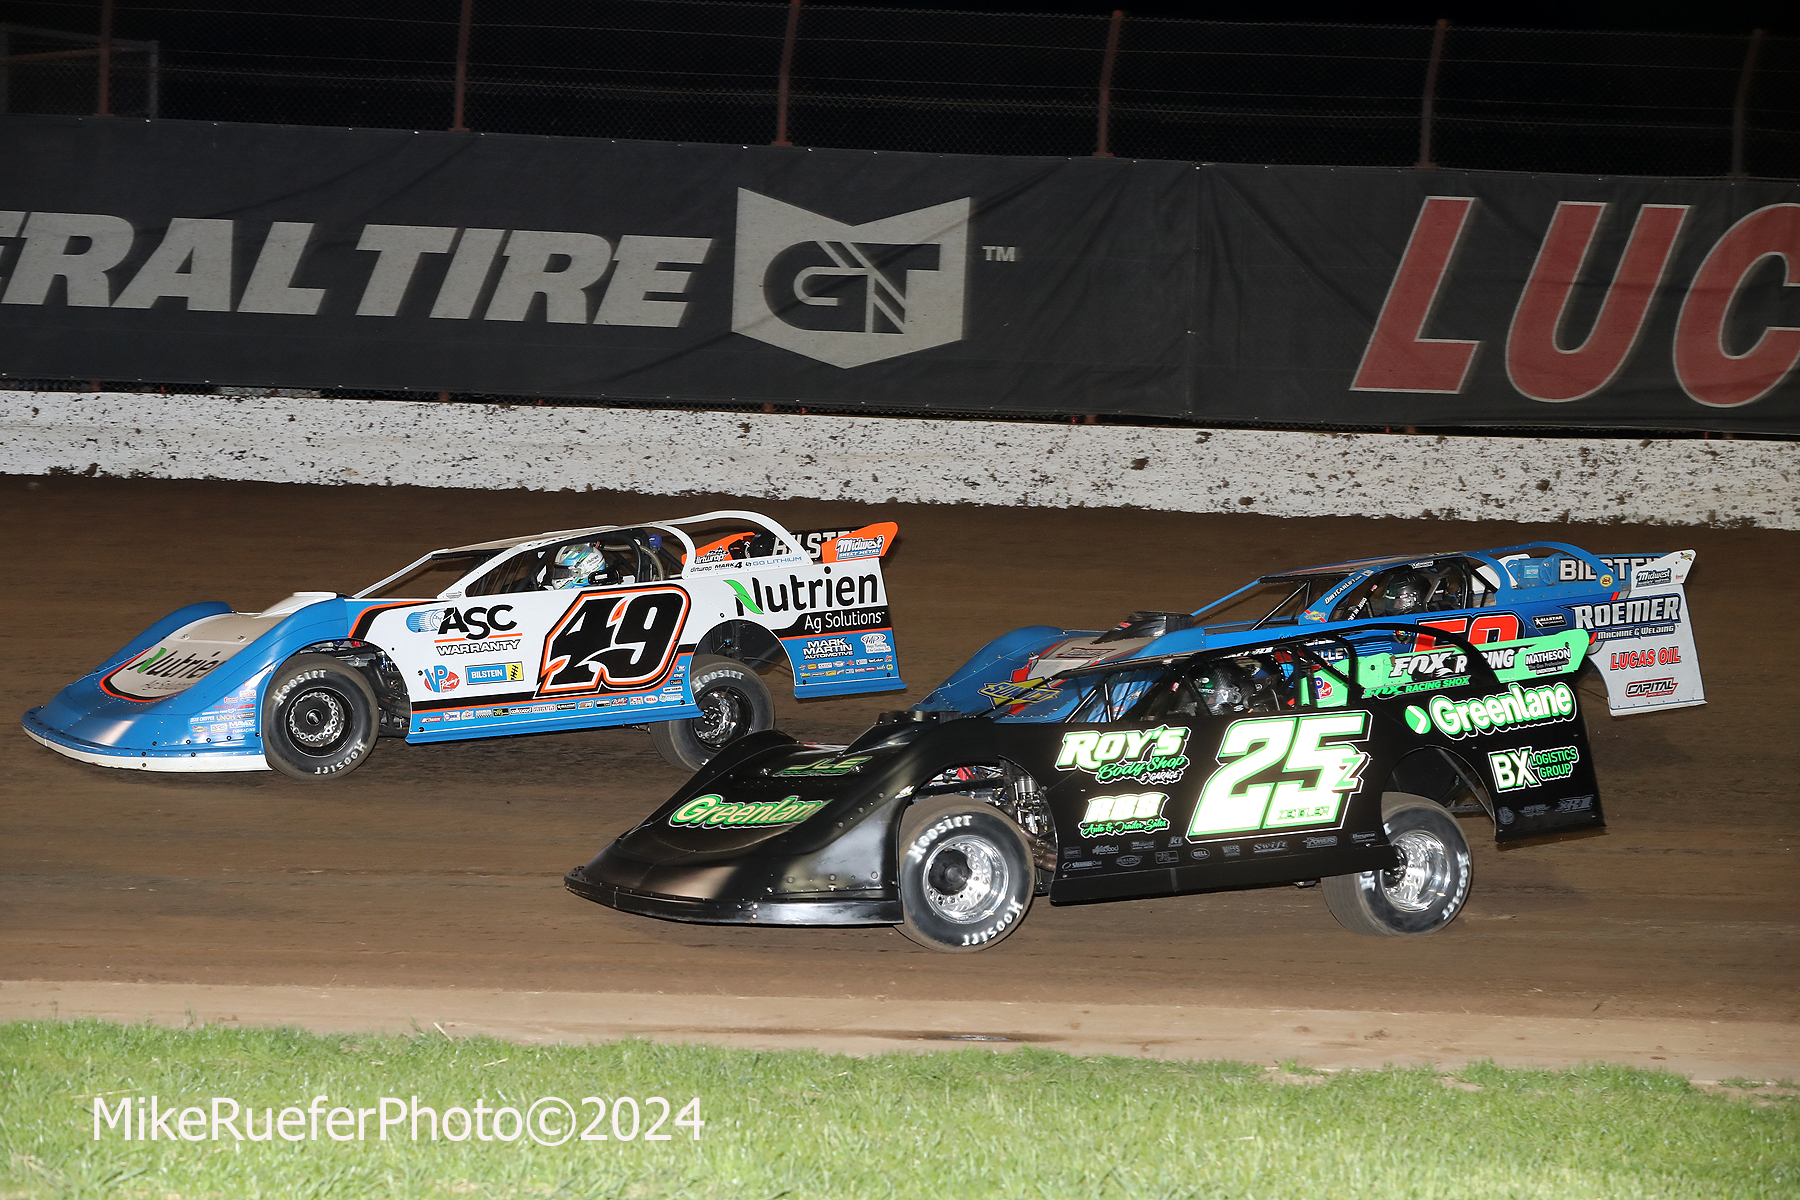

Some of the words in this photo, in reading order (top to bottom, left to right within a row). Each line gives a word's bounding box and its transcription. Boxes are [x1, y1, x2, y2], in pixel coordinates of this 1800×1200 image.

[982, 245, 1016, 263] TM
[0, 211, 327, 316] RAL
[355, 223, 713, 328] TIRE
[766, 556, 803, 565] LITHIUM
[733, 566, 878, 617] Nutrien
[437, 604, 518, 640] ASC
[804, 614, 823, 633] Ag
[825, 610, 882, 629] Solutions
[1570, 596, 1679, 630] ROEMER
[436, 639, 521, 656] WARRANTY
[545, 590, 687, 690] 49
[803, 644, 854, 656] MARTIN
[807, 638, 847, 648] MARK
[127, 650, 226, 680] Nutrie
[804, 650, 854, 660] AUTOMOTIVE
[1389, 651, 1455, 678] FOX
[1454, 648, 1515, 674] RING
[1525, 648, 1571, 665] MATHESON
[1610, 651, 1657, 670] LUCAS
[1658, 646, 1682, 665] OIL
[424, 665, 448, 693] VP
[471, 669, 503, 679] BILSTEIN
[691, 669, 745, 694] Hoosier
[1405, 680, 1441, 693] RACING
[1442, 676, 1470, 688] SHOX
[272, 669, 327, 706] Hoosier
[1627, 681, 1674, 694] CAPITAL
[1430, 684, 1574, 735] Greenlane
[314, 738, 368, 775] Hoosier
[1098, 761, 1146, 780] Body
[1146, 756, 1186, 772] Shop
[1490, 749, 1538, 790] BX
[1530, 748, 1577, 766] LOGISTICS
[1189, 712, 1367, 836] 25
[1540, 763, 1571, 778] GROUP
[906, 814, 973, 864] Hoosier
[1082, 823, 1105, 835] Auto
[1106, 822, 1114, 832] &
[1144, 818, 1166, 830] Sales
[961, 894, 1025, 947] Hoosier
